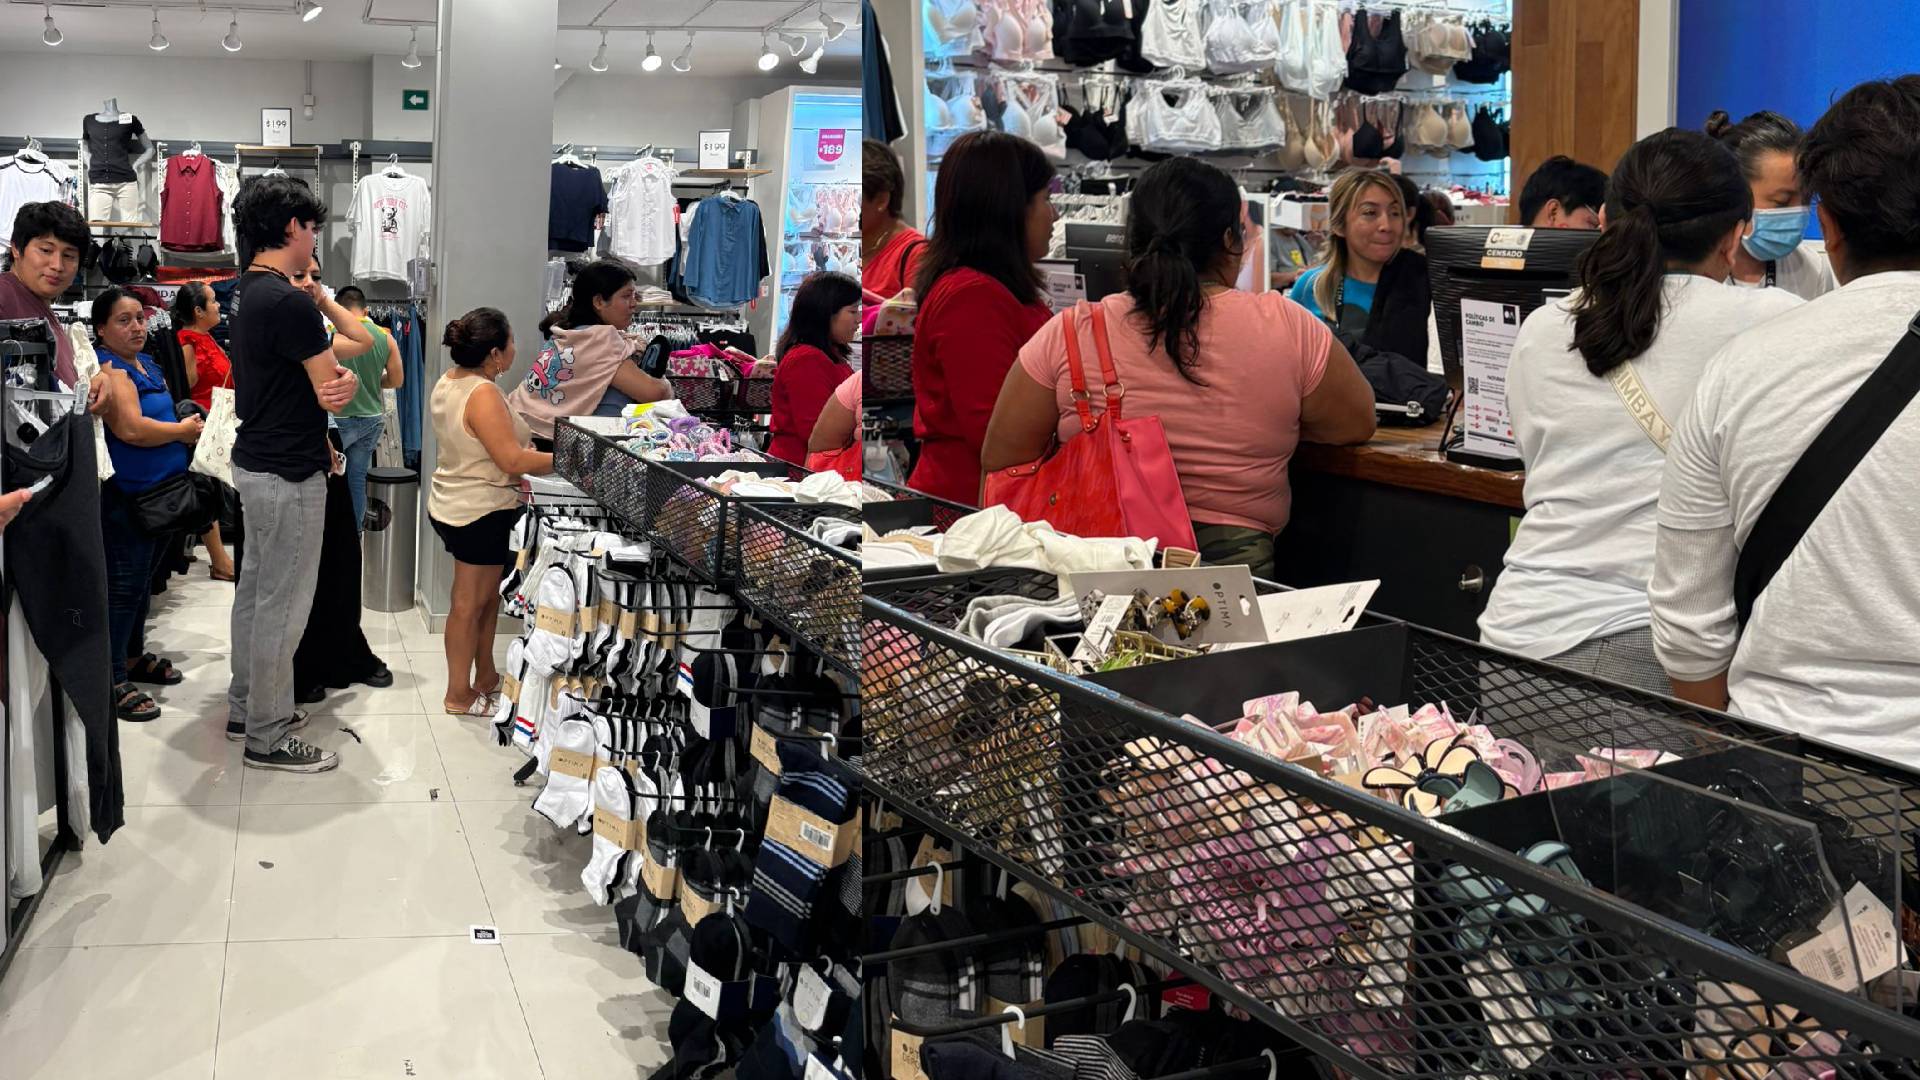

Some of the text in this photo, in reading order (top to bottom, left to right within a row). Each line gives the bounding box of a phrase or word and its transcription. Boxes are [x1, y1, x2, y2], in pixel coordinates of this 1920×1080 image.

[266, 119, 287, 128] $199
[1486, 249, 1523, 258] CENSADO
[1465, 319, 1485, 327] CAMBIO
[1212, 582, 1234, 629] OPTIMA
